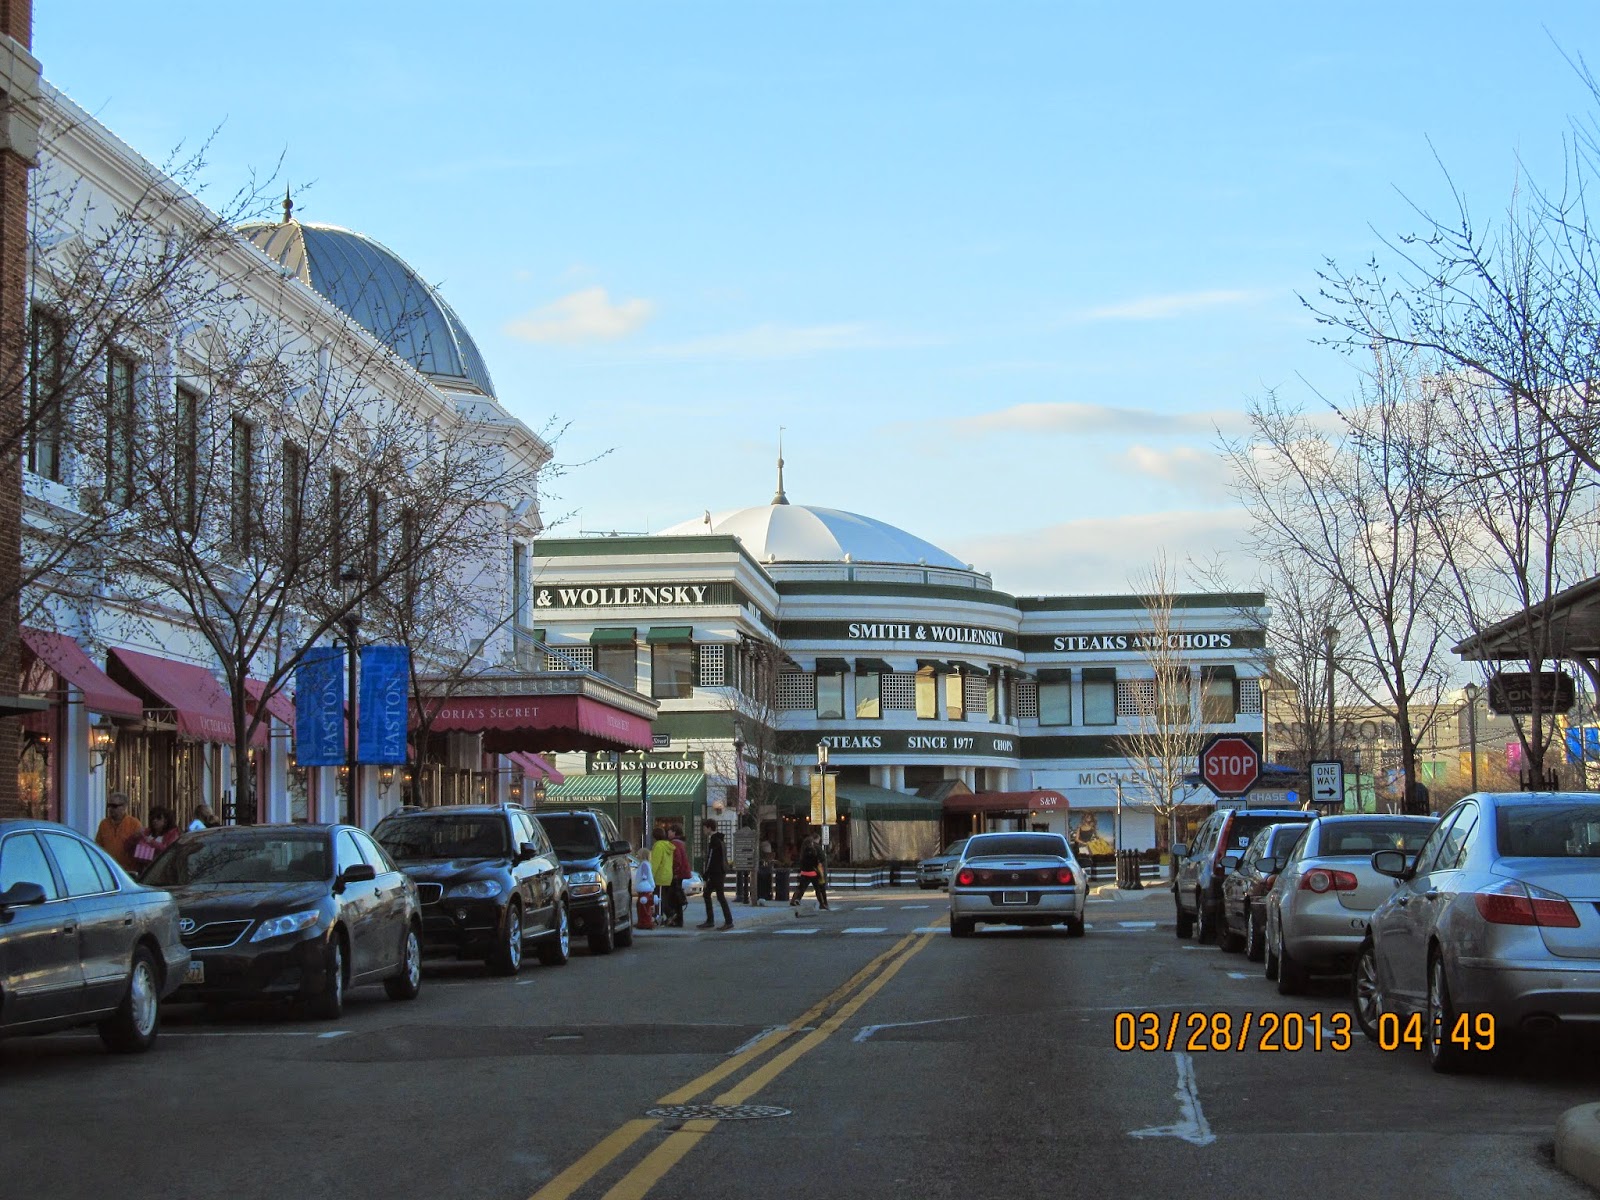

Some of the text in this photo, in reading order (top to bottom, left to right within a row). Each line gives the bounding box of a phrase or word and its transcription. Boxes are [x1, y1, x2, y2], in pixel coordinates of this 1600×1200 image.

[536, 585, 708, 607] & WOLLENSKY
[848, 623, 1004, 646] SMITH & WOLLENSKY
[1053, 633, 1232, 651] STEAKS AND CHOPS
[322, 674, 338, 757] EASTON
[384, 678, 401, 757] EASTON
[821, 735, 882, 749] STEAKS
[908, 736, 974, 750] SINCE 1977
[993, 738, 1013, 752] CHOPS
[591, 761, 636, 771] STEAKS
[658, 760, 699, 770] CHOPS
[1208, 755, 1254, 776] STOP
[1317, 767, 1336, 776] ONE
[1316, 777, 1337, 786] WAY
[1040, 797, 1058, 806] S&W
[1249, 792, 1286, 802] CHASE
